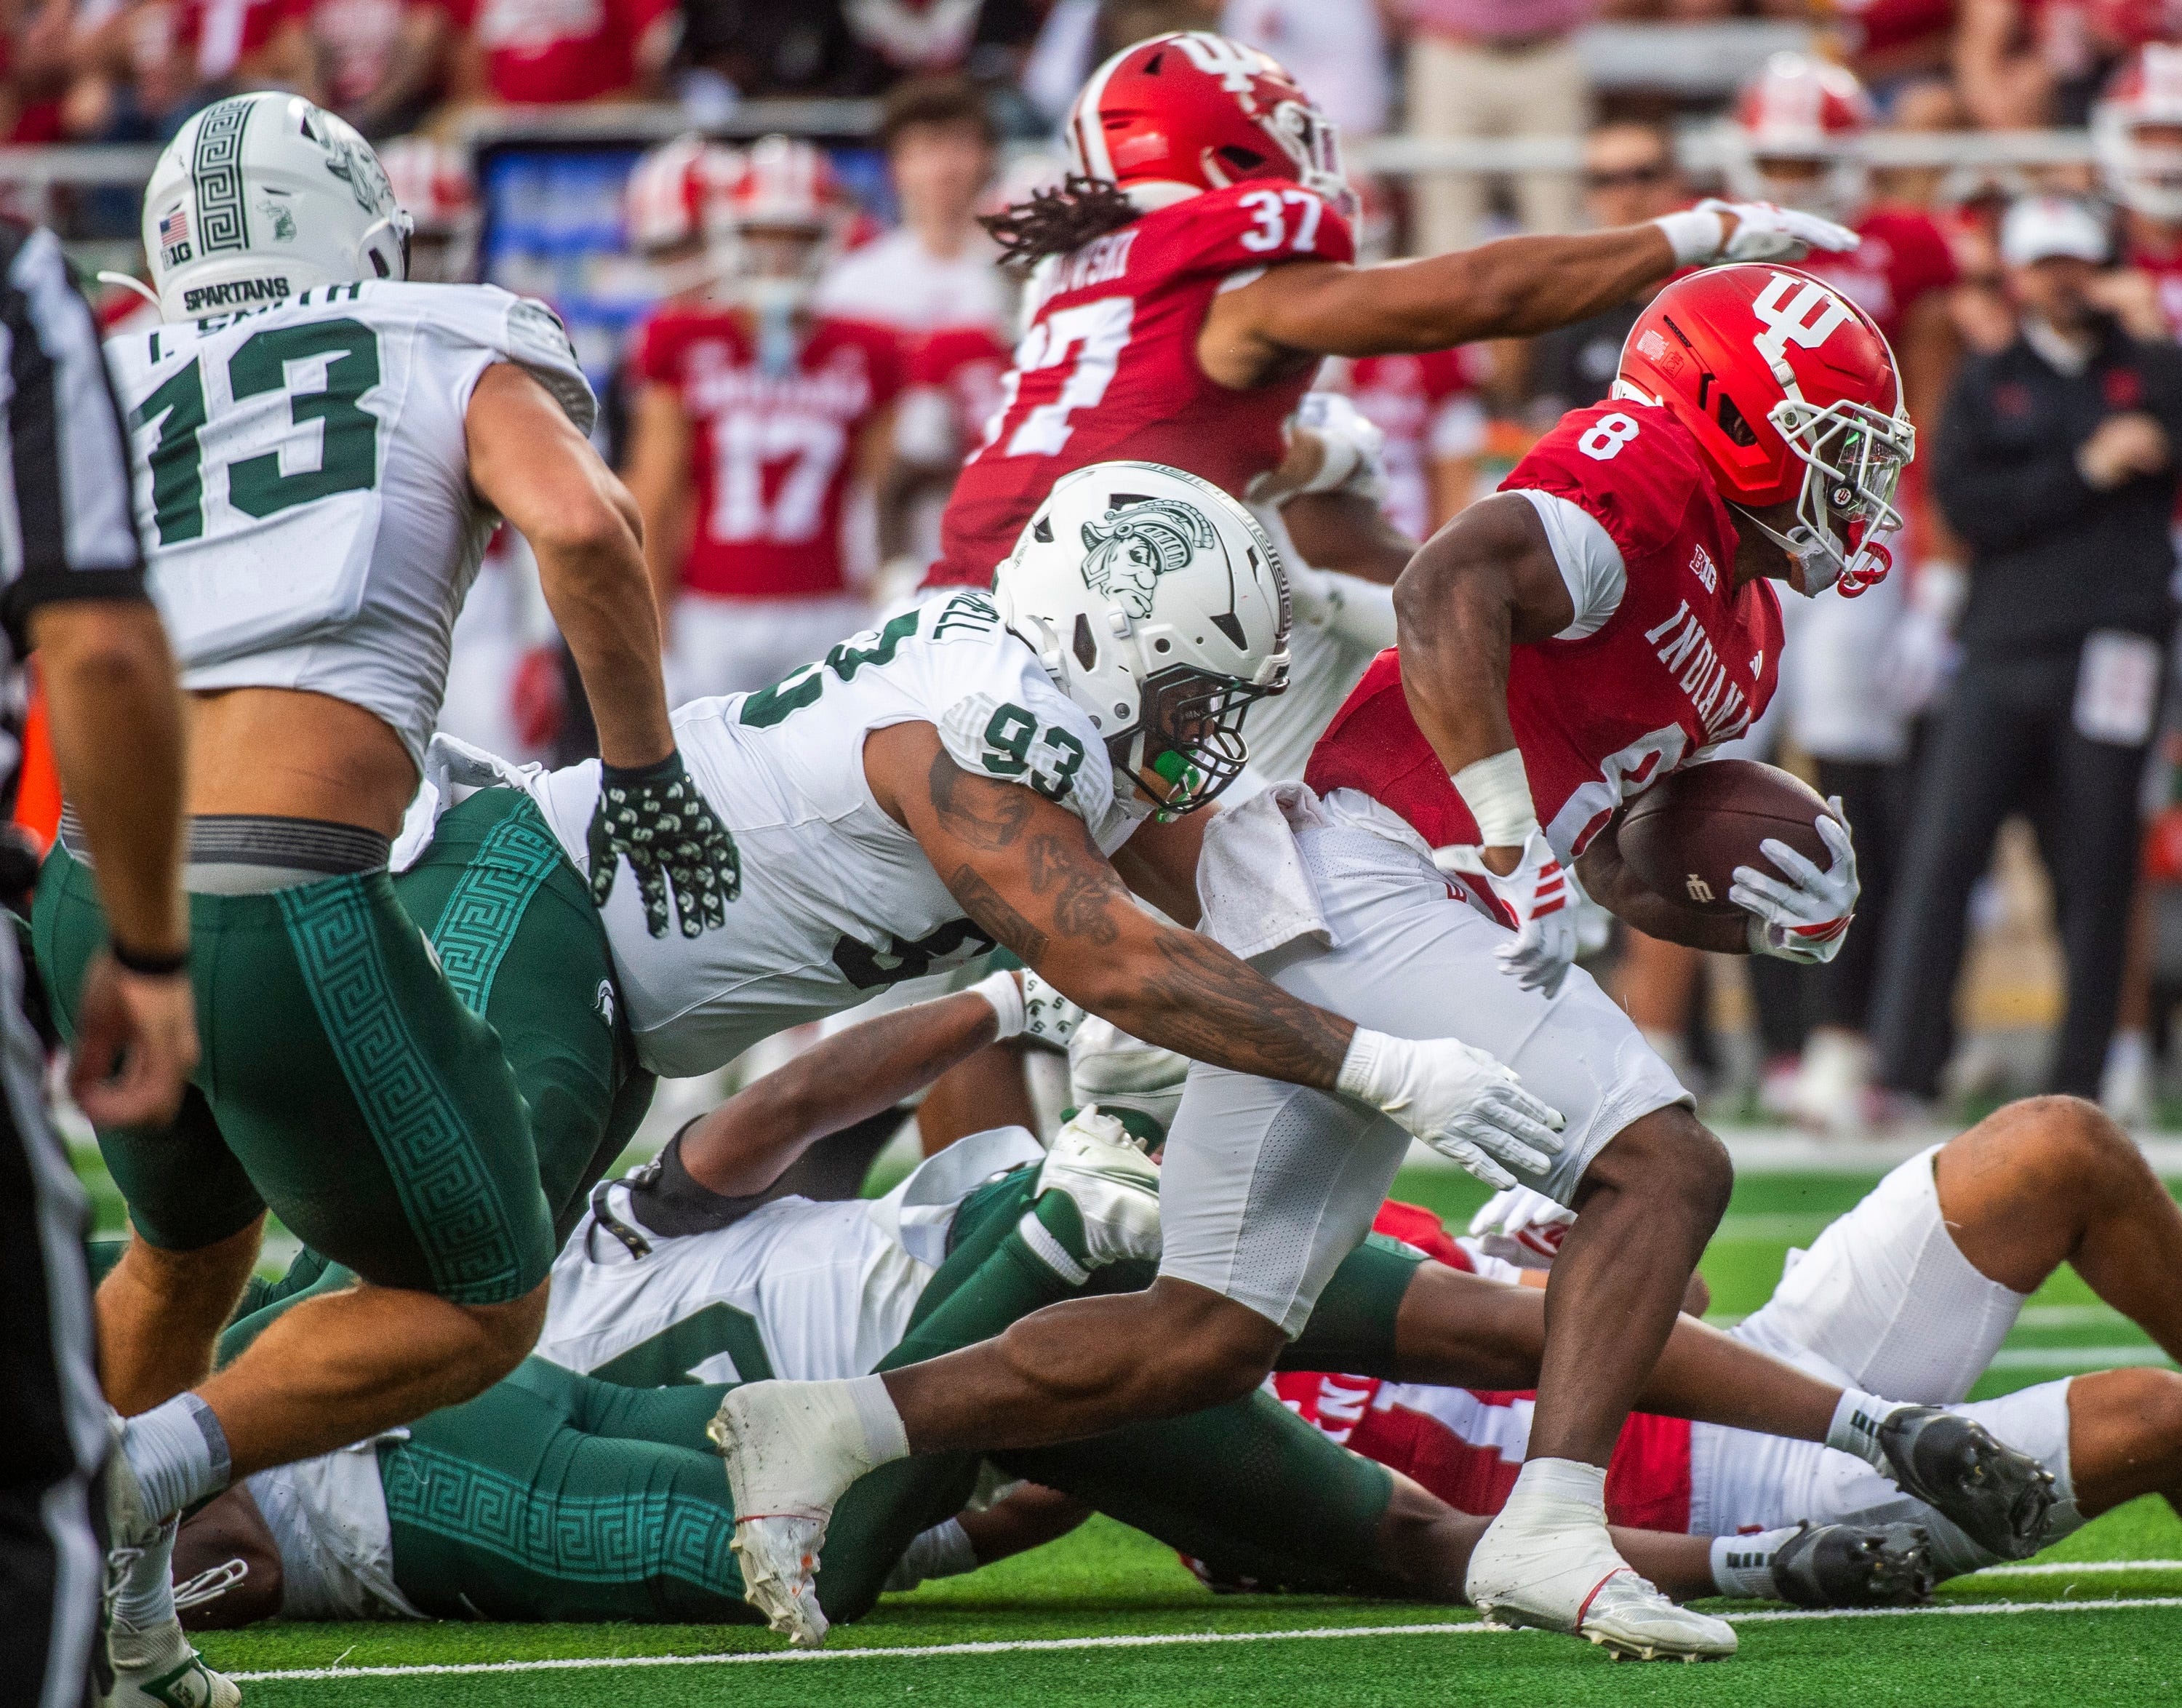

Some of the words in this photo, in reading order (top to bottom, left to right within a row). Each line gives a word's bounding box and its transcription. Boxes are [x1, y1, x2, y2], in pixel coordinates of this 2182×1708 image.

[1239, 190, 1322, 252] 37
[184, 277, 290, 311] SPARTANS
[130, 318, 380, 546] 13
[711, 417, 848, 543] 17
[1578, 412, 1640, 460] 8
[1645, 599, 1751, 743] INDIANA
[982, 702, 1084, 802] 93
